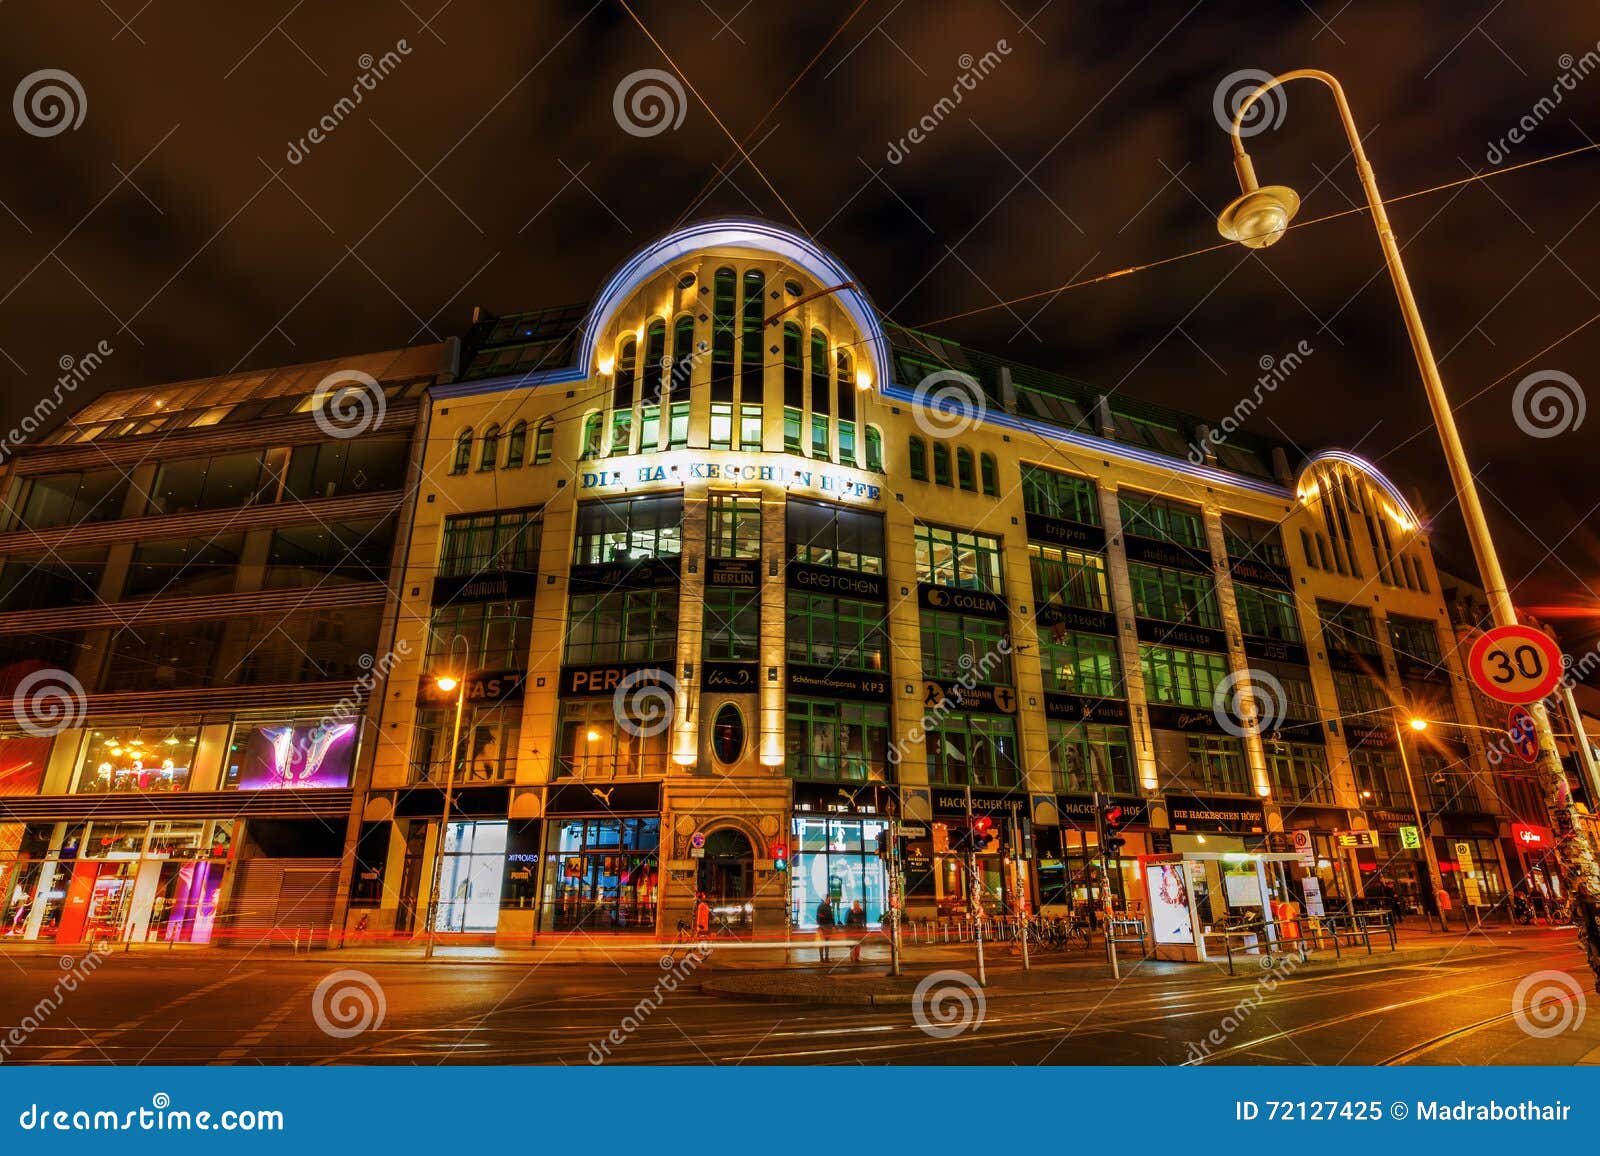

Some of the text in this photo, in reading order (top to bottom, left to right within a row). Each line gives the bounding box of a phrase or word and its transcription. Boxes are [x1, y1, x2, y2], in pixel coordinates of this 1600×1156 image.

[1046, 522, 1086, 541] trippen
[713, 572, 754, 585] BERLIN
[954, 594, 997, 613] GOLEM
[1487, 645, 1542, 684] 30
[946, 687, 991, 700] AMPELMANN
[960, 698, 981, 708] SHOP
[940, 797, 1002, 810] HACKSCHER
[1123, 806, 1141, 816] HOF
[1174, 810, 1187, 819] DIE
[1189, 810, 1239, 820] HACKESCHEN
